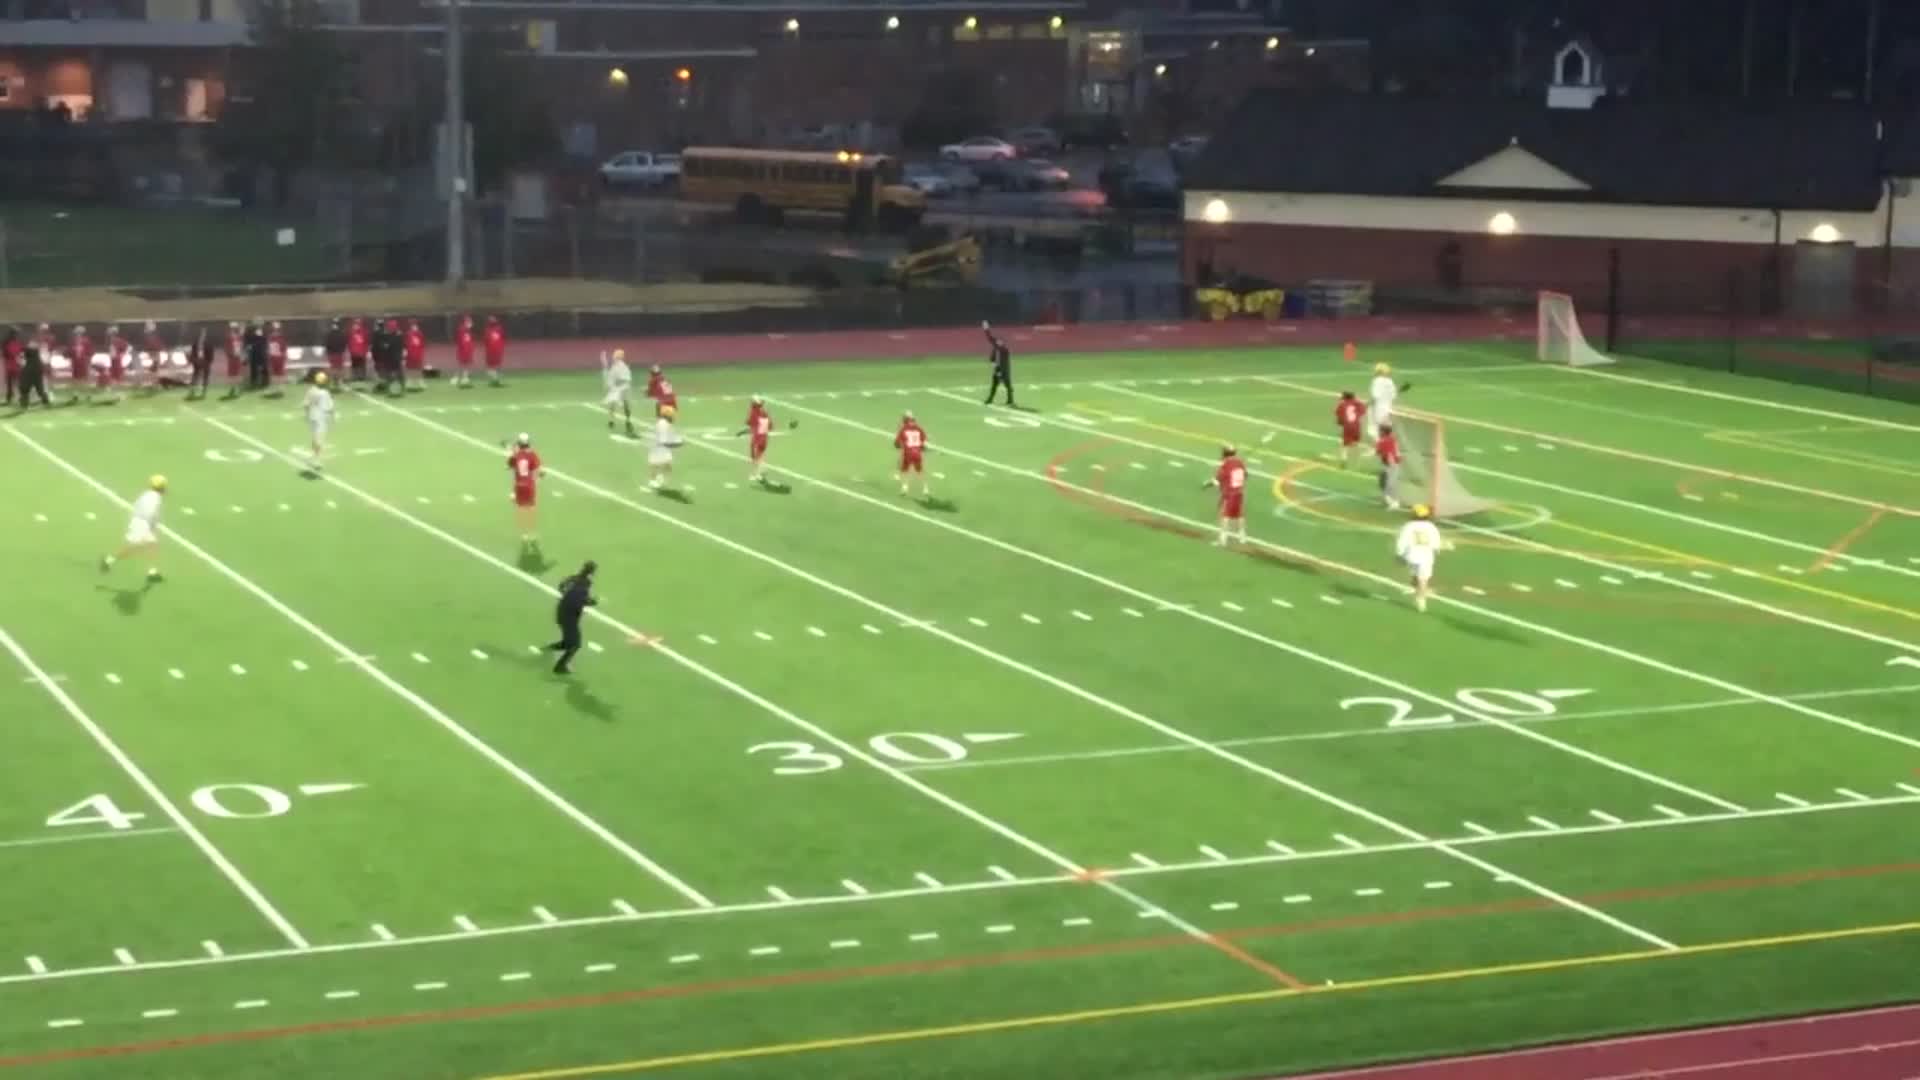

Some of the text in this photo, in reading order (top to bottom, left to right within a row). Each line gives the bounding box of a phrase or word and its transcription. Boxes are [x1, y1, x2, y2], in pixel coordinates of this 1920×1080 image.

[1339, 688, 1557, 727] 20
[746, 732, 968, 774] 30
[46, 783, 292, 828] 40
